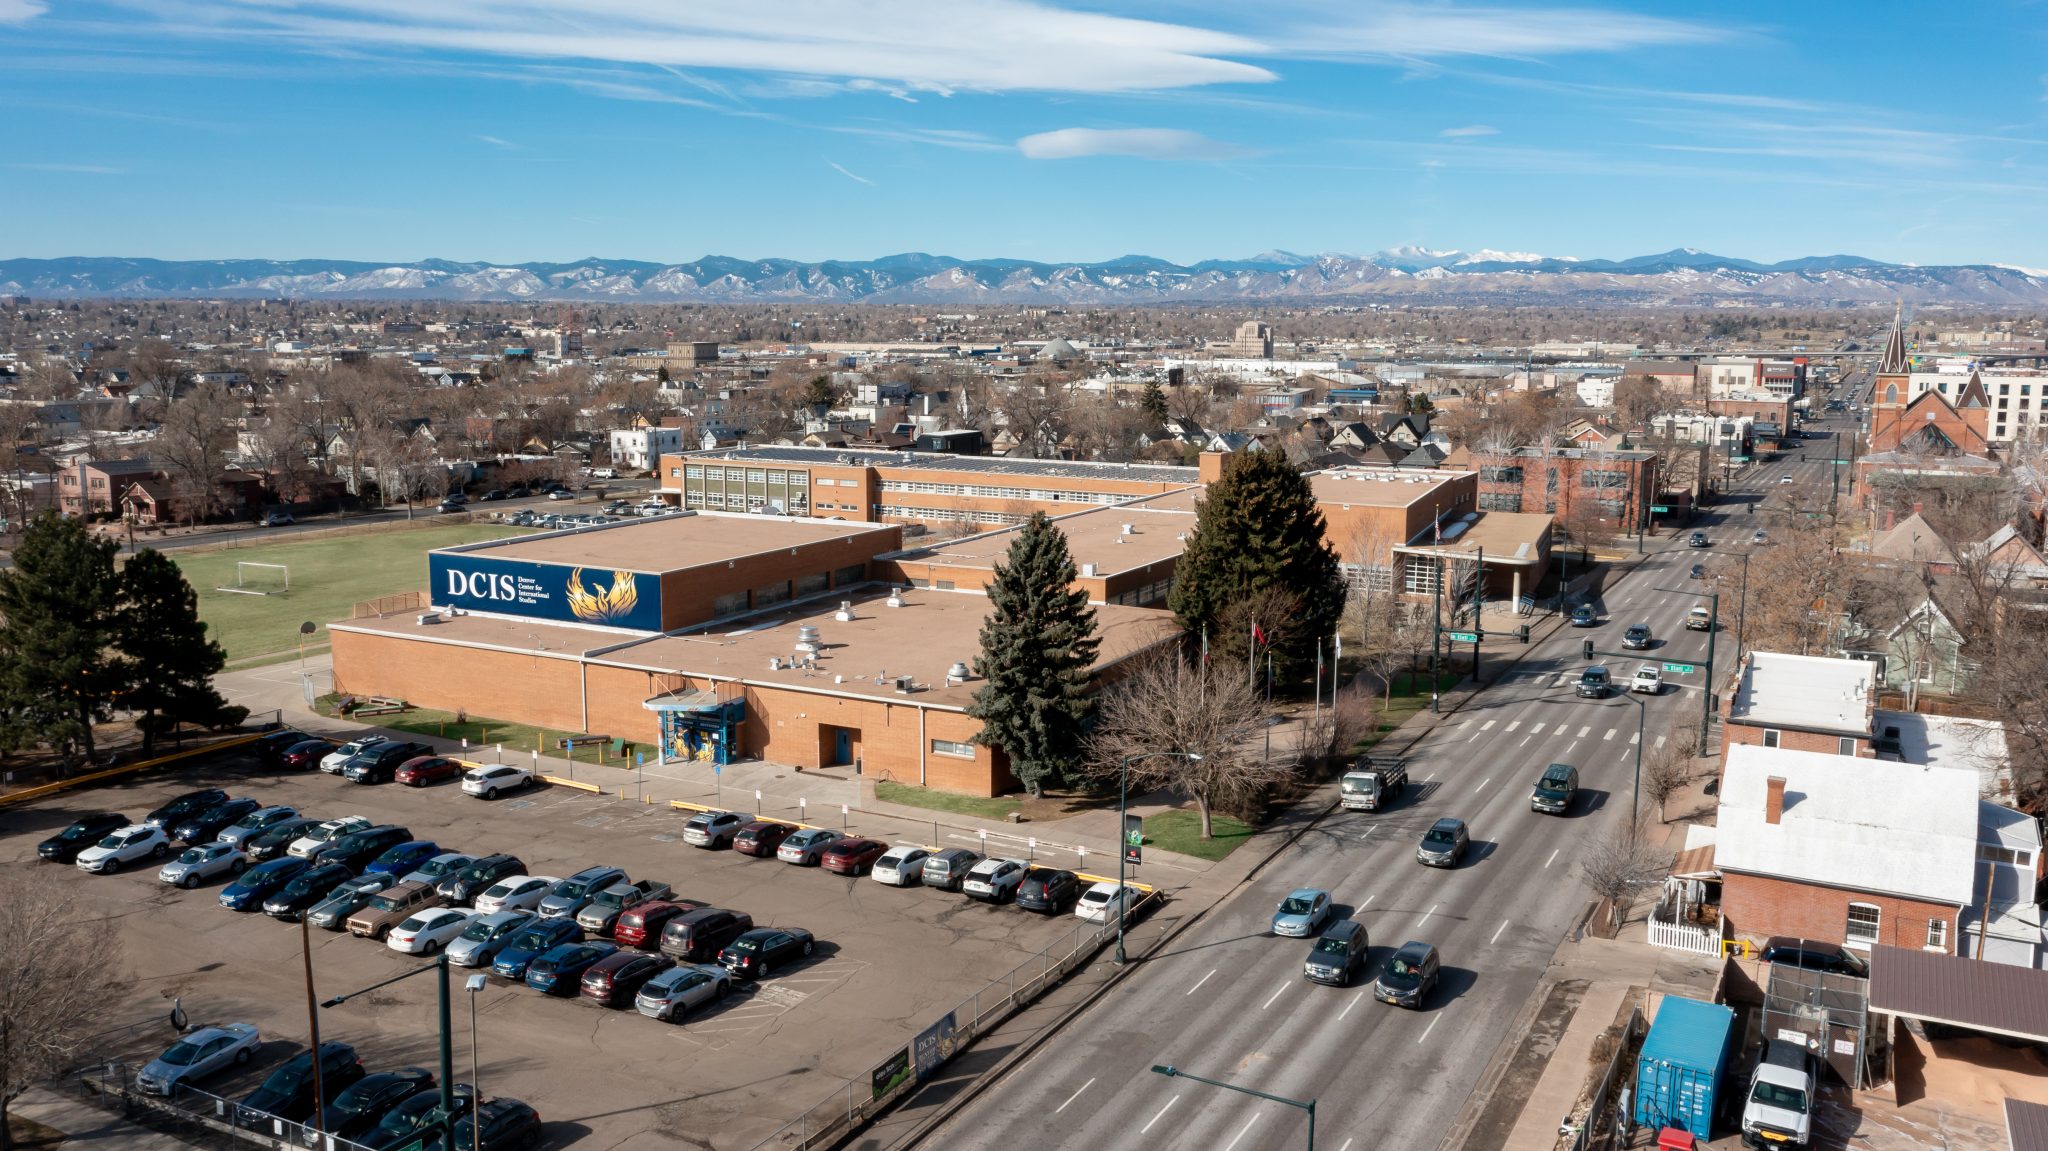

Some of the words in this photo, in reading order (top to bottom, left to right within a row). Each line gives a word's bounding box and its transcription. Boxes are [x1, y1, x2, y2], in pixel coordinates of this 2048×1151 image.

[447, 569, 515, 601] DCIS
[518, 590, 549, 599] International
[918, 1034, 936, 1052] DCIS
